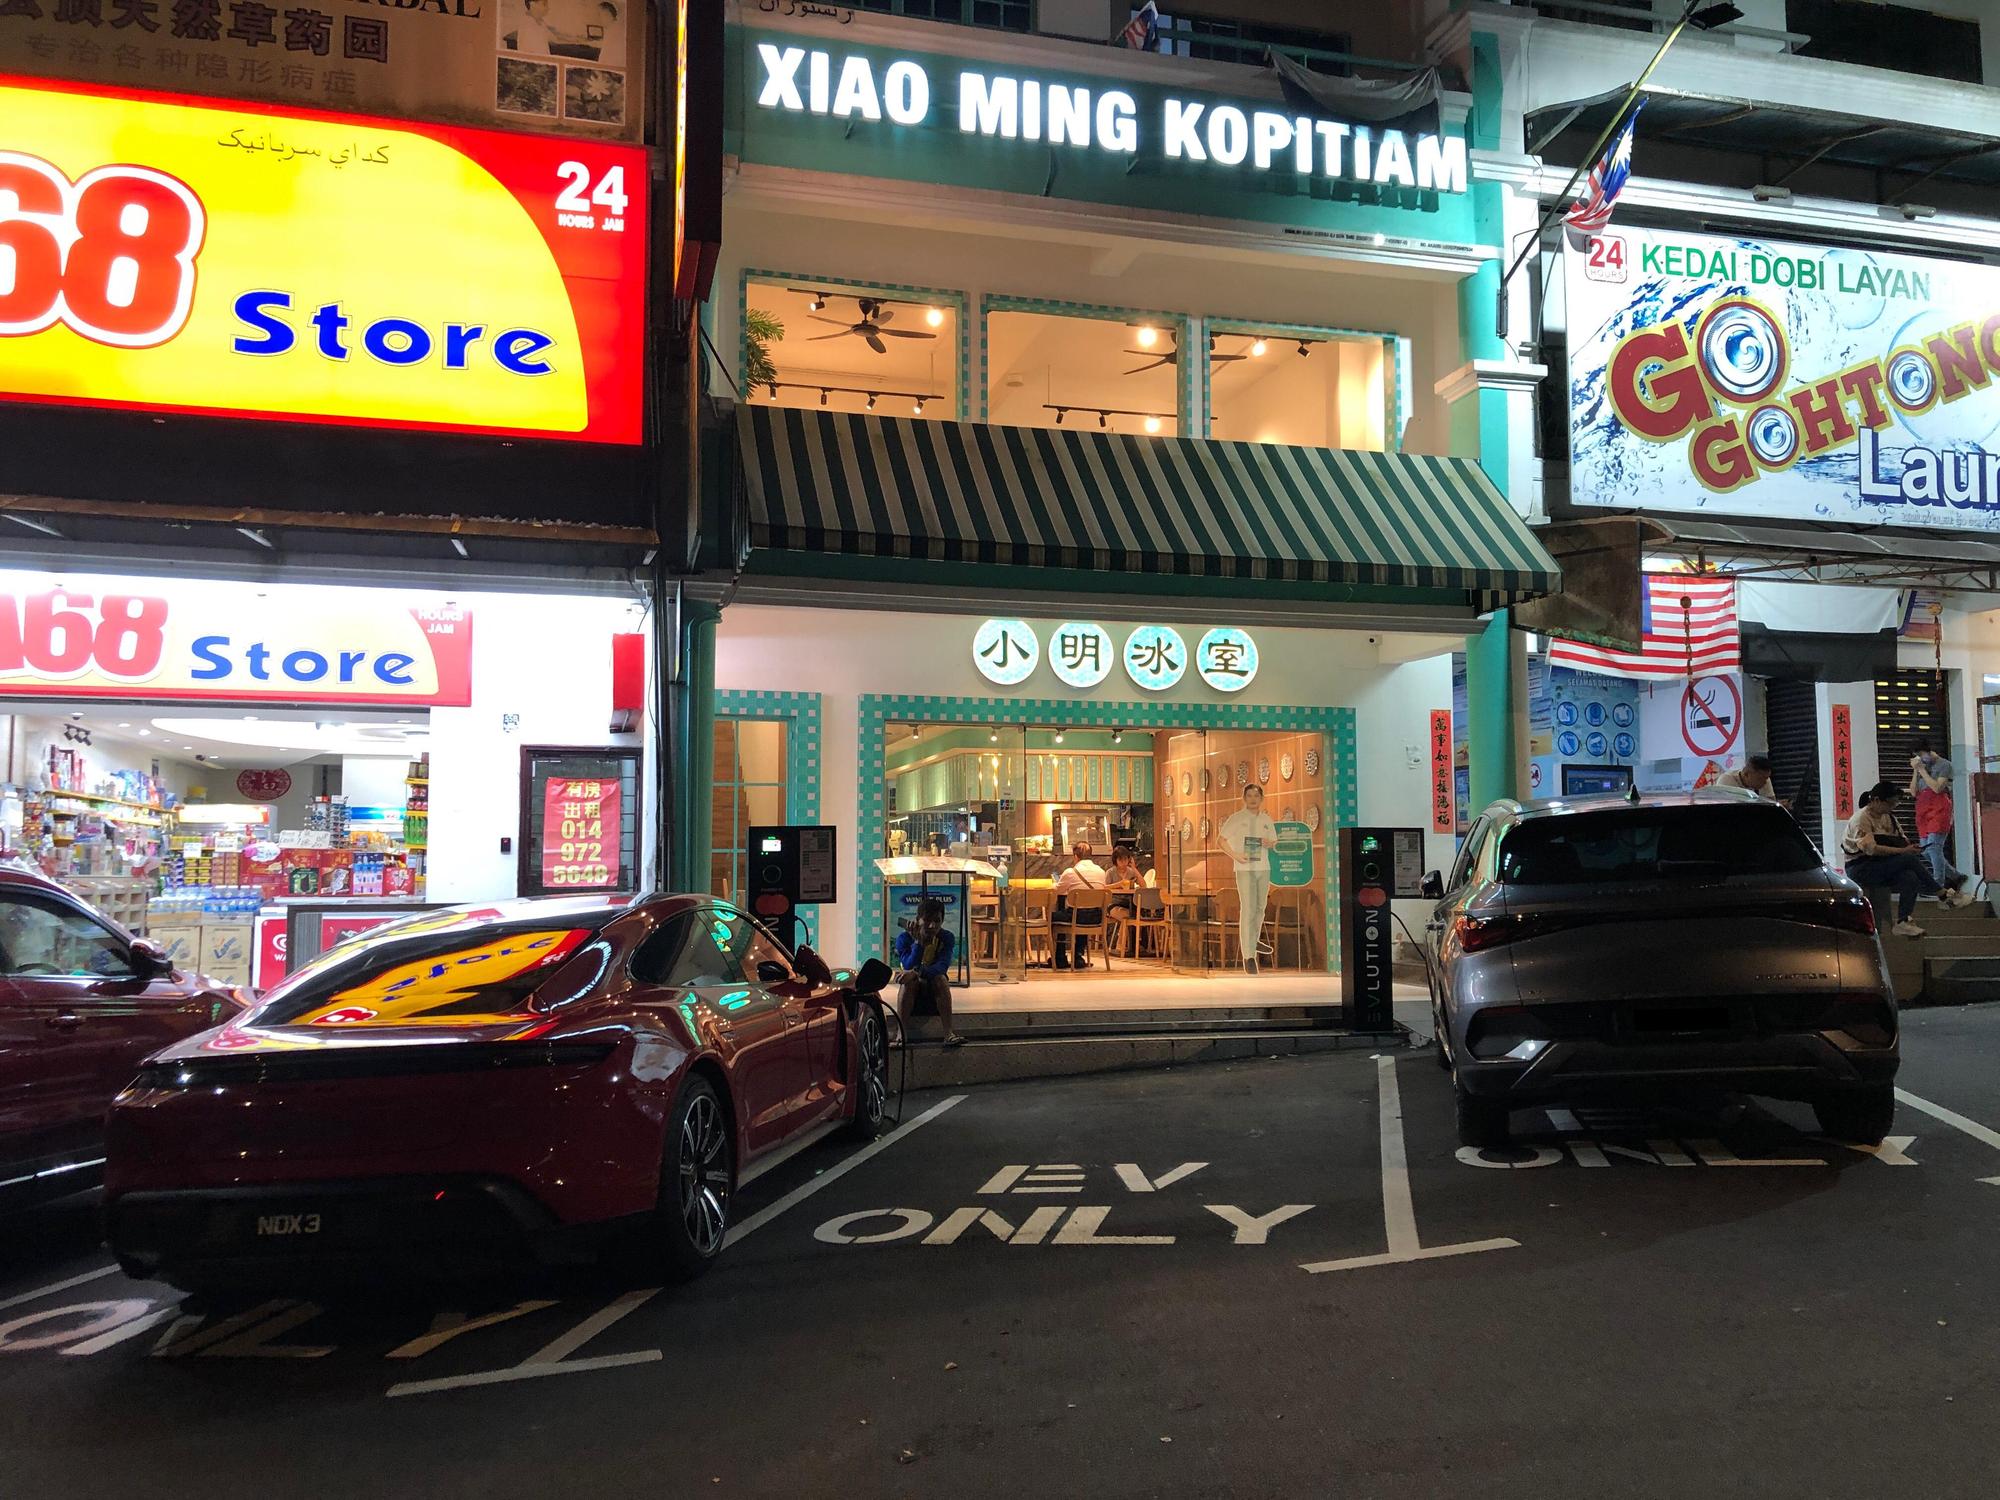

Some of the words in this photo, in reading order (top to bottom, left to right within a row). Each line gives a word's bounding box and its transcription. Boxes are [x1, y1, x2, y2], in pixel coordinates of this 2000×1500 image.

[757, 43, 930, 125] XIAO
[959, 72, 1138, 152] MING
[1164, 98, 1468, 194] KOPITIAM
[555, 160, 628, 215] 24
[558, 213, 595, 229] HOURS
[602, 217, 624, 232] JAM
[1589, 237, 1624, 269] 24
[1642, 242, 1737, 282] KEDAI
[1751, 252, 1825, 291] DOBI
[1838, 262, 1930, 301] LAYAN
[233, 288, 557, 375] Store
[1608, 299, 1789, 441] GO
[427, 623, 454, 634] JAM
[191, 635, 415, 684] Store
[981, 630, 1250, 677] 小明冰室
[566, 782, 601, 798] 有房
[564, 801, 601, 818] 出租
[561, 820, 603, 839] 014
[560, 842, 602, 862] 972
[977, 1162, 1210, 1194] EV
[304, 1214, 320, 1233] 3
[813, 1204, 1316, 1245] ONLY
